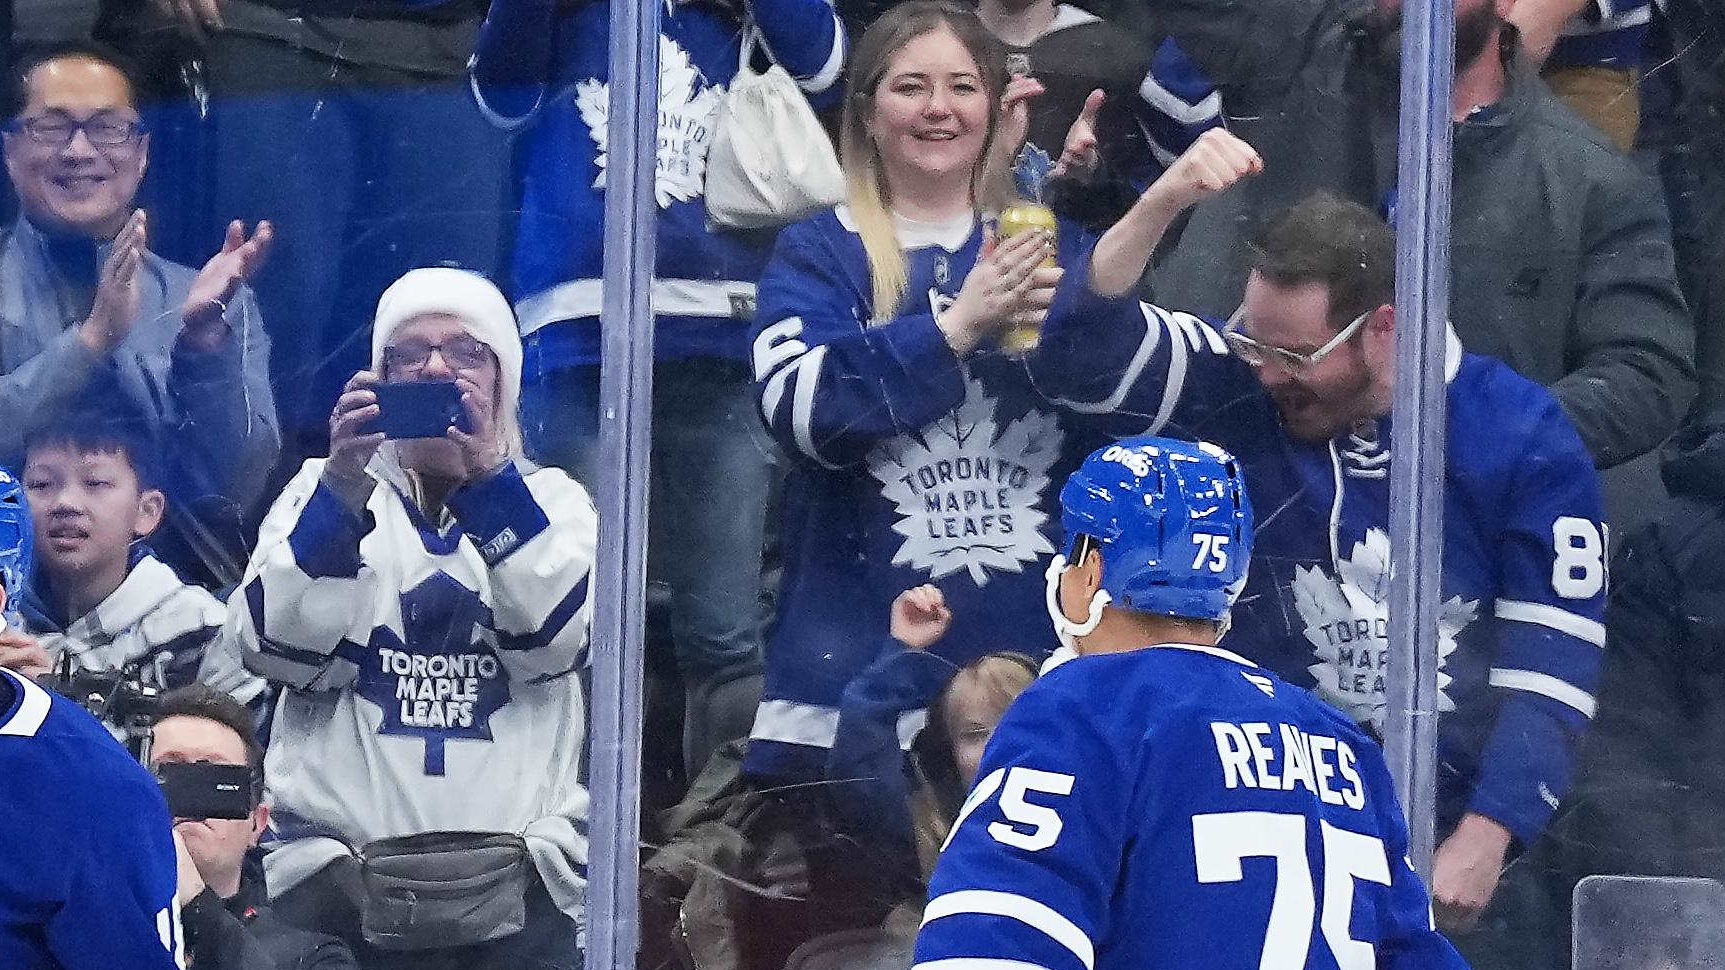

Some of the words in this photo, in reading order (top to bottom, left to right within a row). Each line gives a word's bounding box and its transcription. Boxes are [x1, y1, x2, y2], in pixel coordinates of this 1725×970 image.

[898, 456, 1029, 496] TORONTO
[924, 488, 1011, 513] MAPLE
[927, 514, 1014, 539] LEAFS
[1192, 533, 1230, 573] 75
[1552, 516, 1610, 599] 8
[1319, 618, 1388, 646] TORO
[378, 648, 498, 679] TORONTO
[1338, 646, 1388, 668] MAP
[395, 675, 478, 702] MAPLE
[1338, 673, 1387, 693] LEA
[399, 700, 475, 728] LEAFS
[1210, 721, 1365, 811] REAVES
